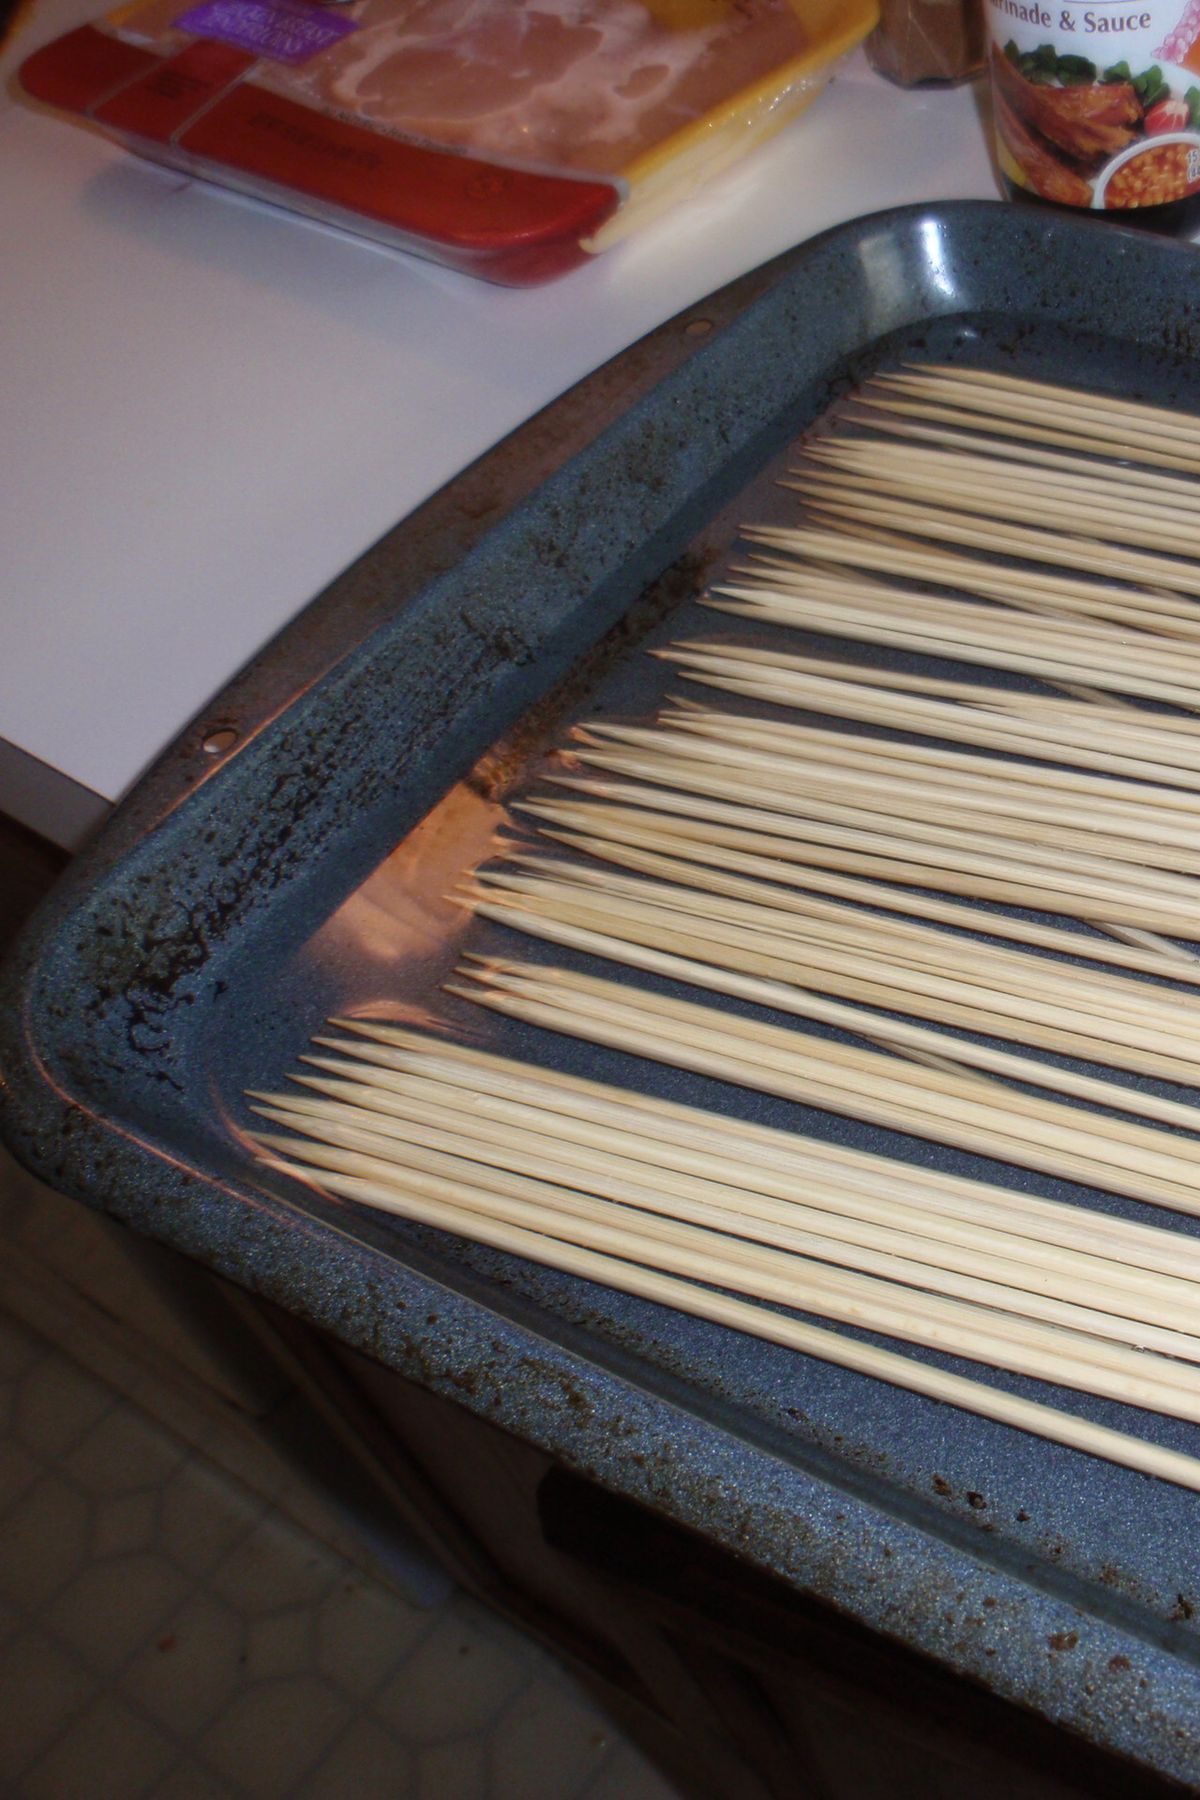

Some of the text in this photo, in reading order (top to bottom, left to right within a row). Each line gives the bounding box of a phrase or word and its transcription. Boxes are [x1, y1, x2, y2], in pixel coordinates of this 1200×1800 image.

[990, 0, 1151, 33] rinade & Sauce
[1187, 150, 1198, 163] 15
